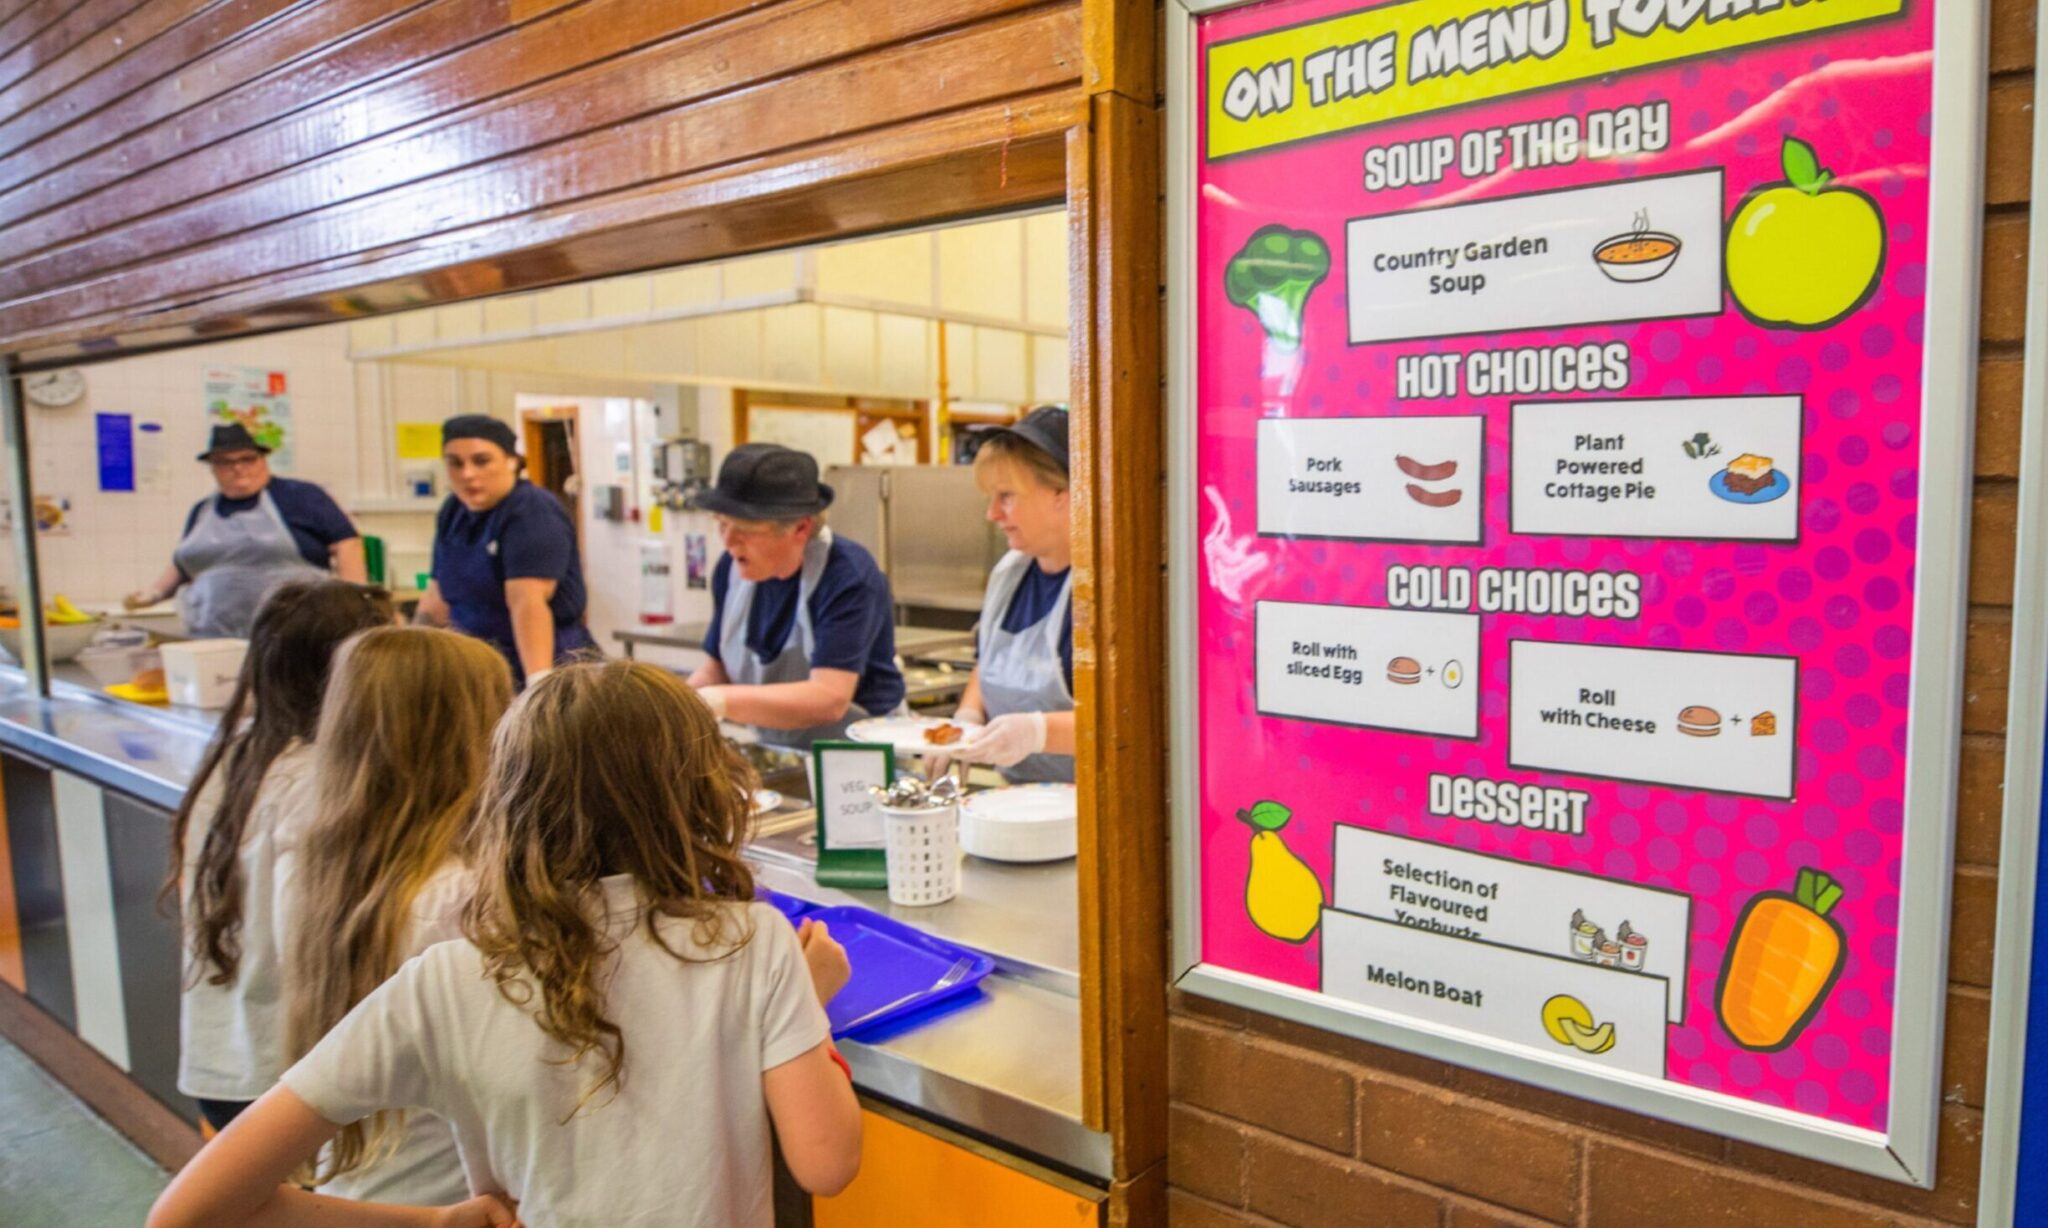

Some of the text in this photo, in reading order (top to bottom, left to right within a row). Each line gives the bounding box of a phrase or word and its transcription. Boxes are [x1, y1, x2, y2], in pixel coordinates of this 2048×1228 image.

[1223, 58, 1293, 121] ON
[1303, 32, 1397, 107] THE
[1408, 1, 1569, 85] MENU
[1363, 137, 1456, 191] SOUP
[1459, 127, 1504, 178] OF
[1374, 236, 1548, 272] Country Garden
[1430, 274, 1486, 294] Soup
[1396, 353, 1462, 400] HOT
[1574, 434, 1625, 451] Plant
[1307, 457, 1342, 472] Pork
[1556, 458, 1643, 475] Powered
[1289, 478, 1361, 497] Sausages
[1545, 482, 1655, 502] Cottage Pie
[1387, 564, 1471, 610] COLD
[1292, 641, 1357, 660] Roll with
[1287, 660, 1362, 685] sliced Egg
[1580, 688, 1615, 706] Roll
[1540, 708, 1656, 734] with Cheese
[841, 801, 873, 816] SOUP
[1383, 858, 1499, 900] Selection of
[1390, 884, 1488, 922] Flavoured
[1367, 964, 1484, 1007] Melon Boat
